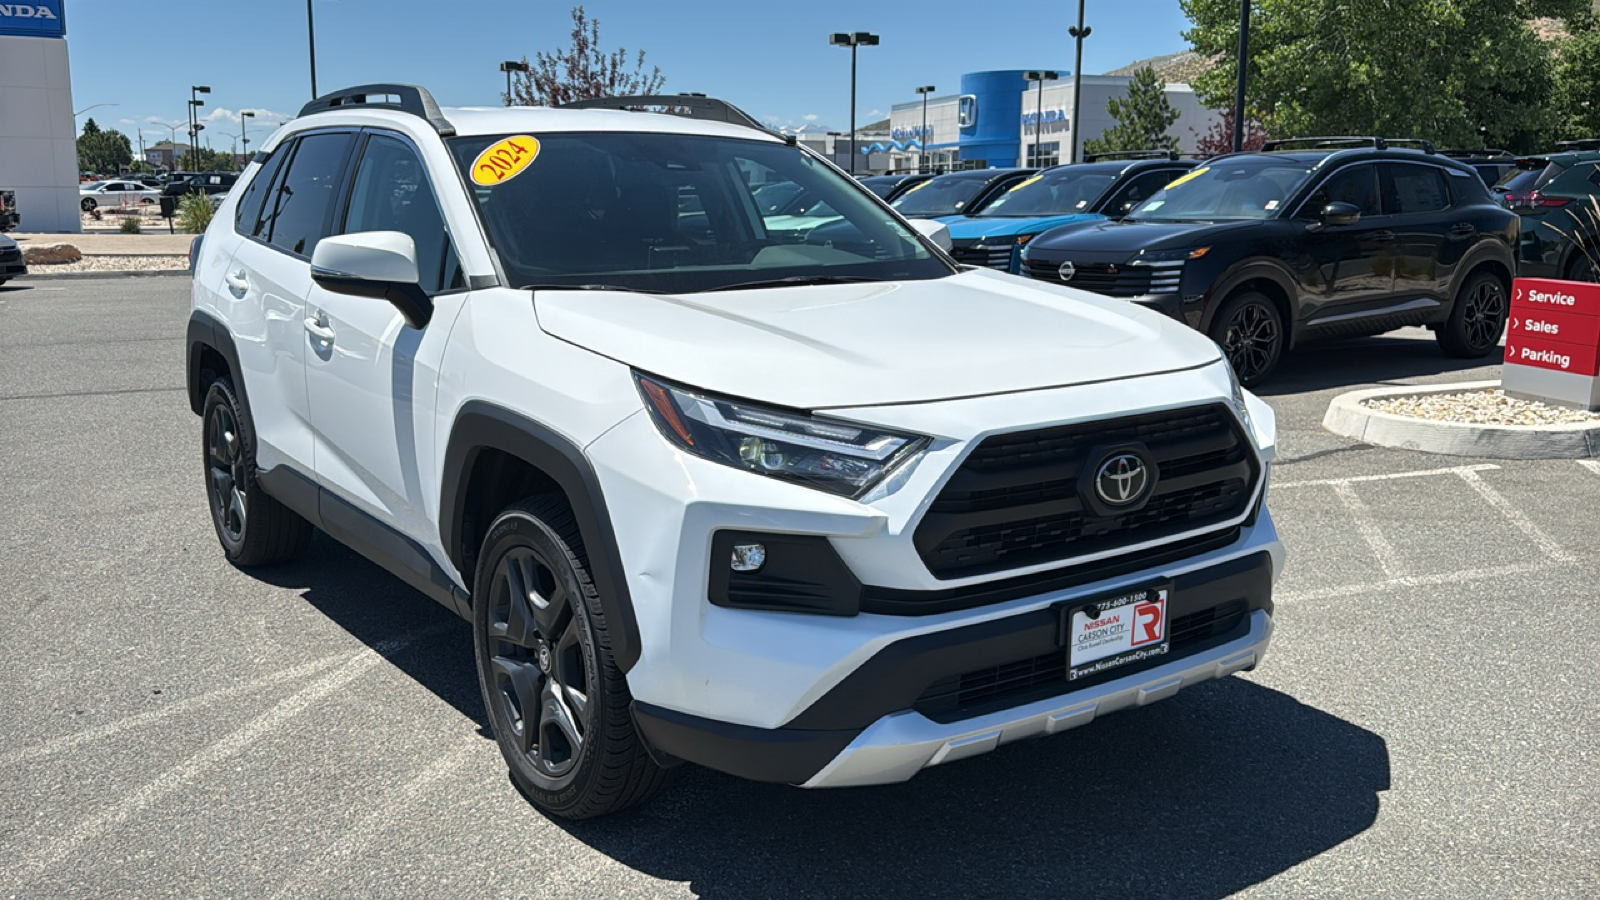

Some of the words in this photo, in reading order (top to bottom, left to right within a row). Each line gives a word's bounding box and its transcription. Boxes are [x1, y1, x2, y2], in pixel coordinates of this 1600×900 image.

[1021, 109, 1066, 125] HONDA
[480, 140, 529, 180] 2024
[1528, 289, 1575, 306] Service
[1524, 319, 1559, 334] Sales
[1521, 347, 1570, 368] Parking
[1084, 615, 1120, 631] NISSAN
[1078, 628, 1109, 643] CARSON
[1109, 623, 1126, 636] CITY
